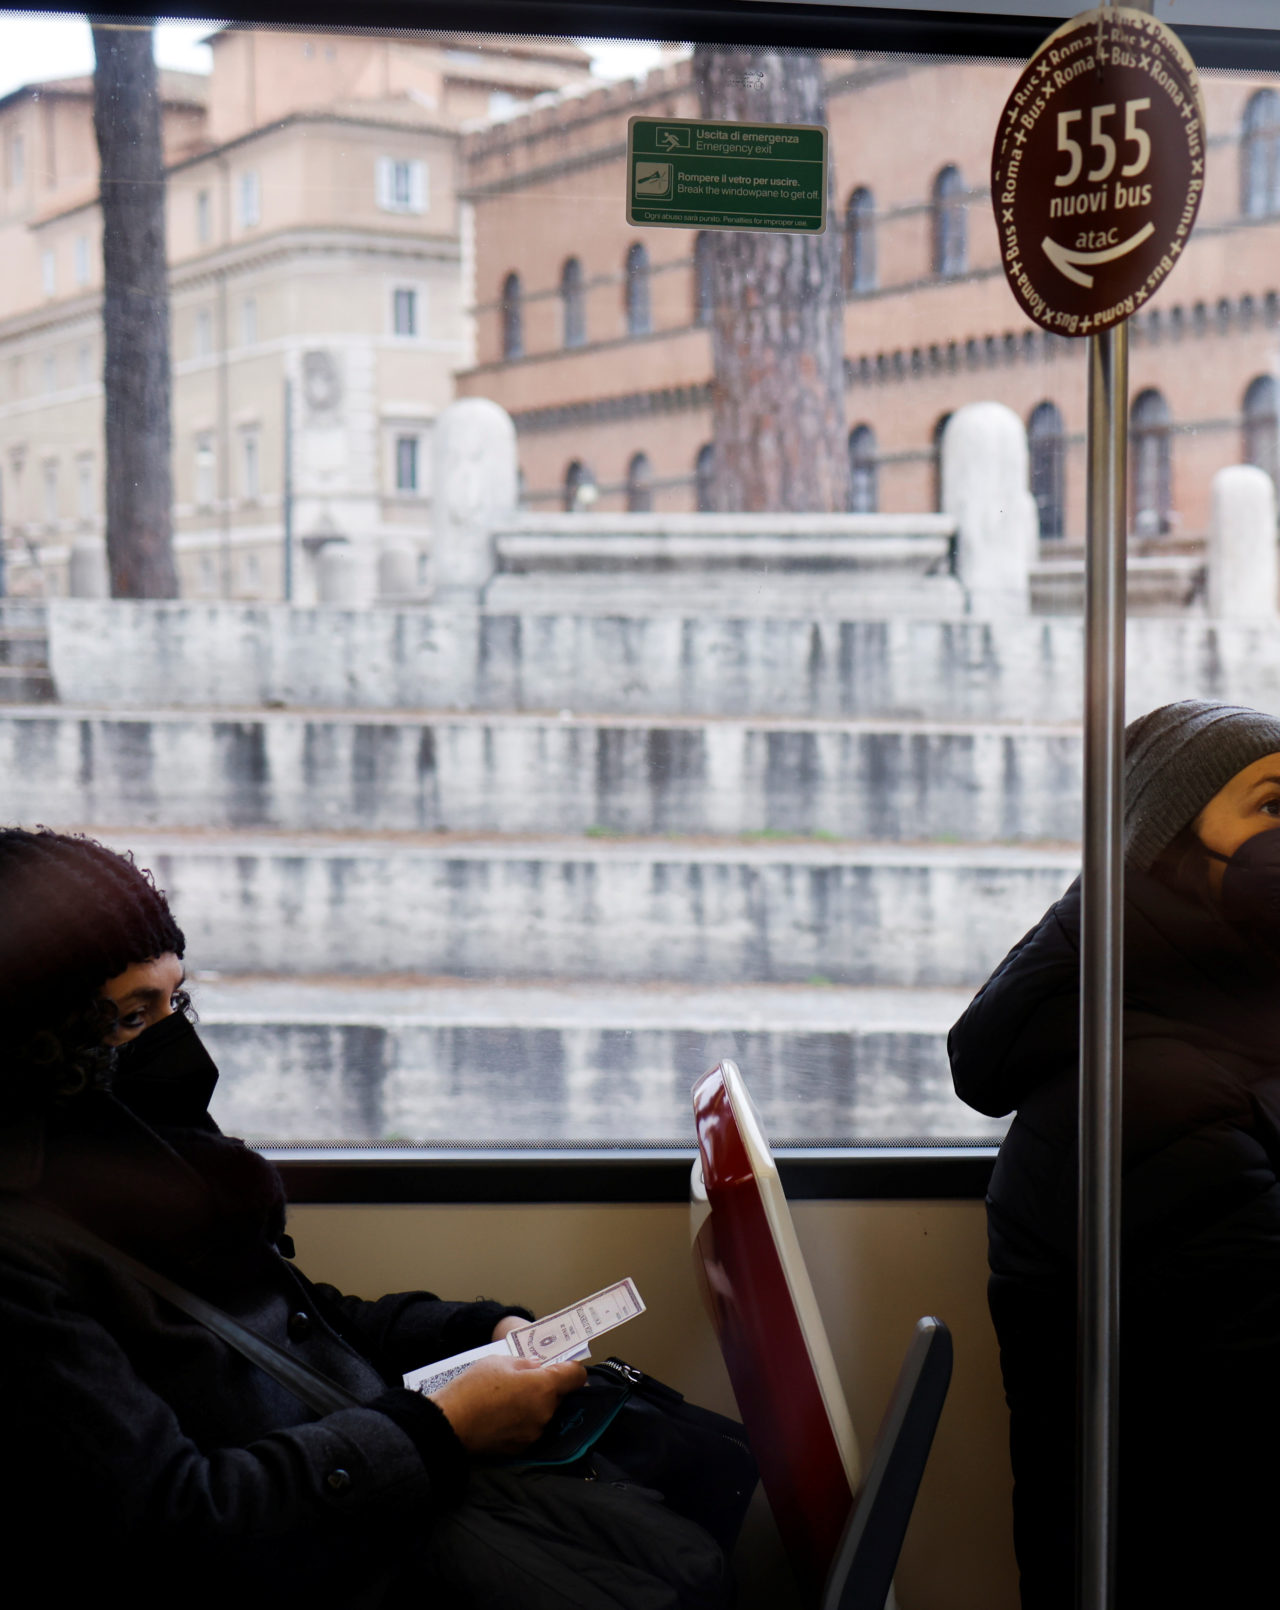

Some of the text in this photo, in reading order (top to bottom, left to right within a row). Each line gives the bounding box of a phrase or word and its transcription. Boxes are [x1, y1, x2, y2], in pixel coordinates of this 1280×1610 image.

[1052, 55, 1095, 88] Roma
[1111, 46, 1137, 68] Bus
[1149, 59, 1184, 107] Roma
[1020, 97, 1046, 130] Bus
[696, 129, 800, 145] Uscita di emergenza
[696, 140, 772, 155] Emergency exit
[1054, 97, 1151, 187] 555
[1185, 118, 1201, 157] Bus
[677, 172, 800, 187] Rompere il vetro per uscire.
[677, 183, 704, 194] Break
[705, 185, 720, 195] the
[721, 187, 779, 198] windowpane
[780, 189, 790, 198] to
[790, 190, 806, 201] get
[1001, 148, 1023, 203] Roma
[1050, 181, 1152, 218] nuovi bus
[1176, 179, 1202, 236] Roma
[1005, 225, 1020, 261] Bus
[1075, 226, 1119, 249] atac
[1146, 255, 1173, 288] Bus
[1017, 272, 1046, 317] Roma
[1093, 295, 1135, 326] Roma
[1053, 311, 1080, 333] Bus
